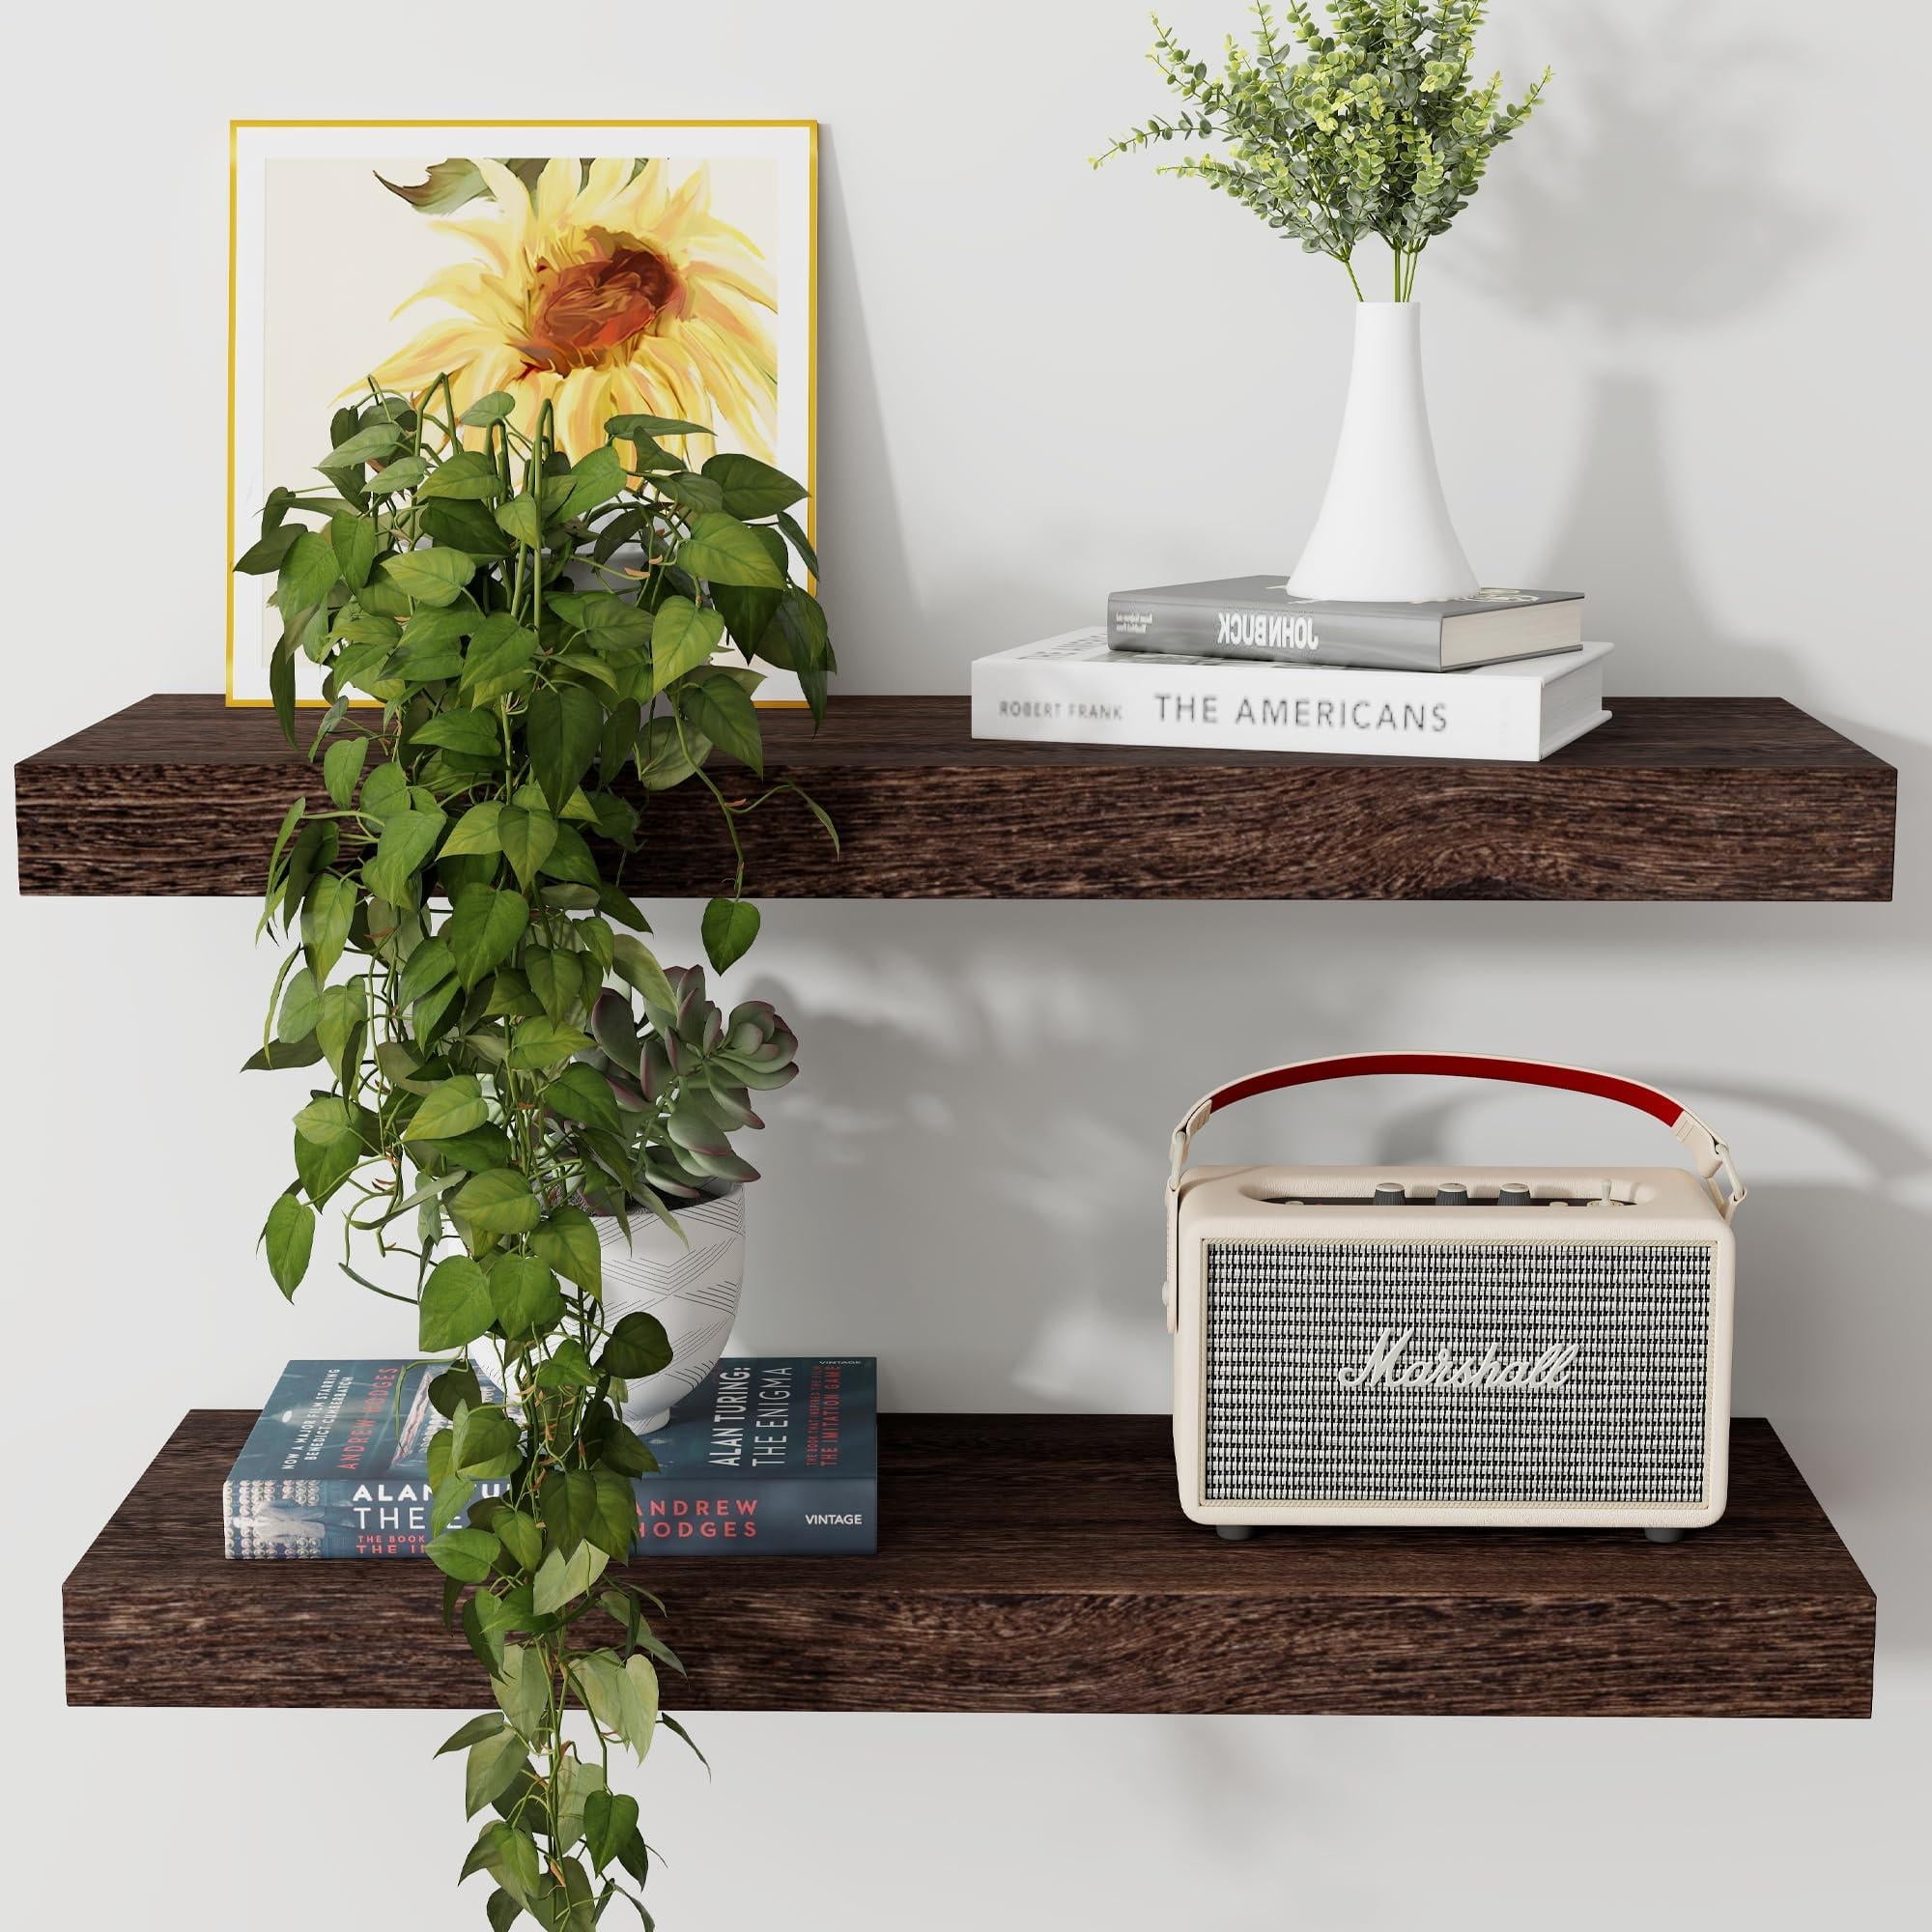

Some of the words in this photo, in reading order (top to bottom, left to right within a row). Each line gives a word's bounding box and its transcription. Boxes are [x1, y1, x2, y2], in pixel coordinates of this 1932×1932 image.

[999, 700, 1061, 718] ROBERT
[1067, 703, 1123, 720] FRANK
[1154, 694, 1218, 724] THE
[1236, 697, 1448, 732] AMERICANS
[1339, 1327, 1579, 1388] Marshall
[714, 1367, 751, 1422] TURING:
[823, 1366, 841, 1389] GAME
[755, 1367, 792, 1429] ENIGMA
[281, 1453, 299, 1469] NOW
[294, 1420, 316, 1443] MAJOR
[307, 1402, 325, 1418] FILM
[316, 1368, 340, 1400] STARRING
[304, 1427, 331, 1461] BENEDICT
[322, 1377, 354, 1424] CUMBERBATCH
[336, 1419, 376, 1469] ANDREW
[362, 1368, 398, 1413] HODGES
[821, 1394, 840, 1443] IMITATION
[708, 1428, 743, 1466] ALAN
[752, 1435, 786, 1466] THE
[820, 1448, 838, 1466] THE
[354, 1507, 425, 1530] THE
[806, 1514, 863, 1525] VINTAGE
[356, 1545, 397, 1554] THE
[357, 1535, 382, 1544] THE
[388, 1534, 425, 1544] BOOK
